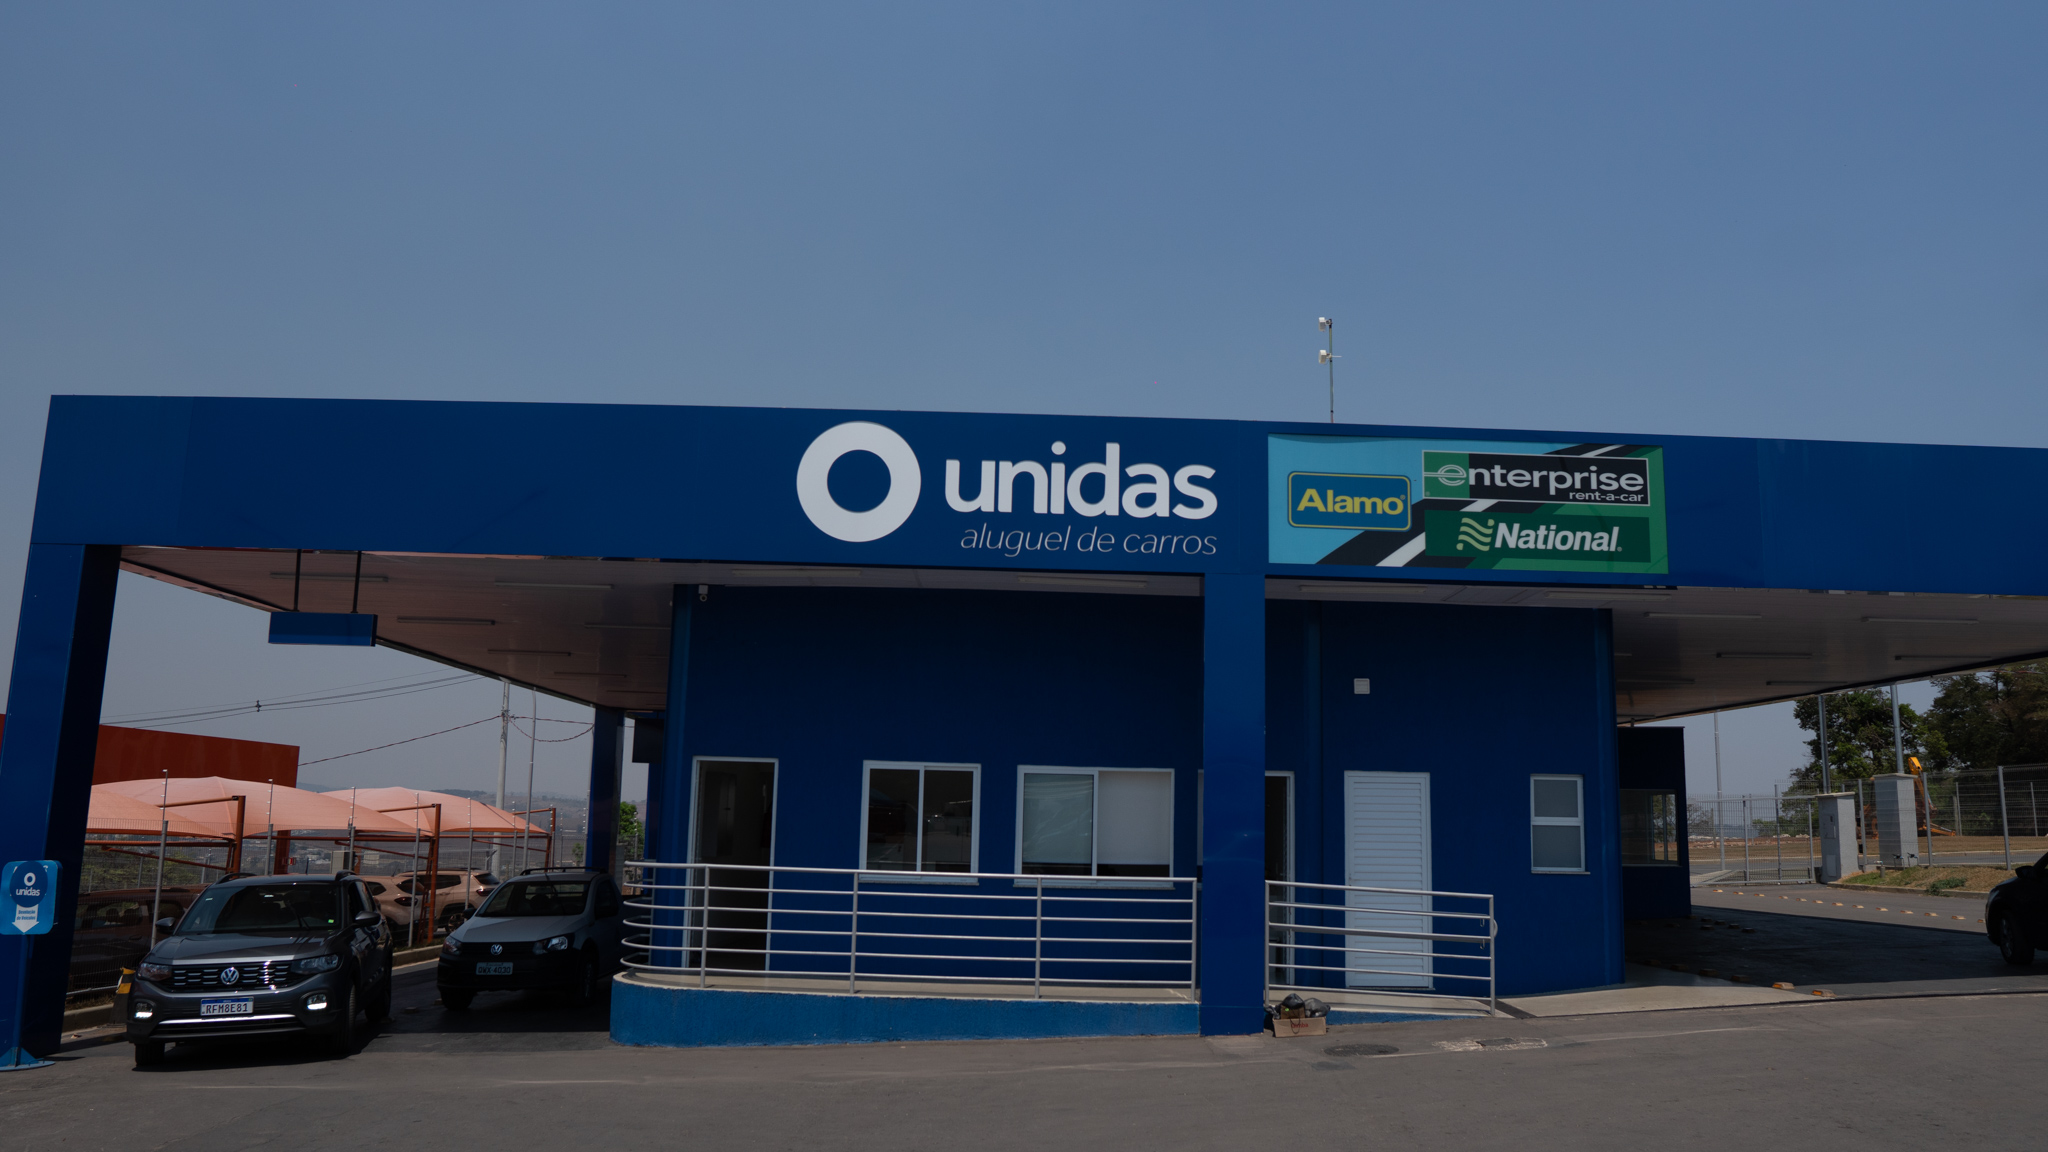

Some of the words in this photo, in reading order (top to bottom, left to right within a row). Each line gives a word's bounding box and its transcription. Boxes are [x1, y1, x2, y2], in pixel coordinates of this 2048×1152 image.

[945, 440, 1218, 520] unidas
[1437, 464, 1645, 496] enterprise
[1296, 488, 1404, 516] Alamo
[1569, 491, 1645, 503] rent-a-car
[960, 523, 1071, 557] aluguel
[1076, 526, 1115, 552] de
[1123, 533, 1218, 555] carros
[1494, 522, 1620, 552] National
[16, 887, 41, 897] unidas
[206, 1003, 248, 1014] RFM8E81
